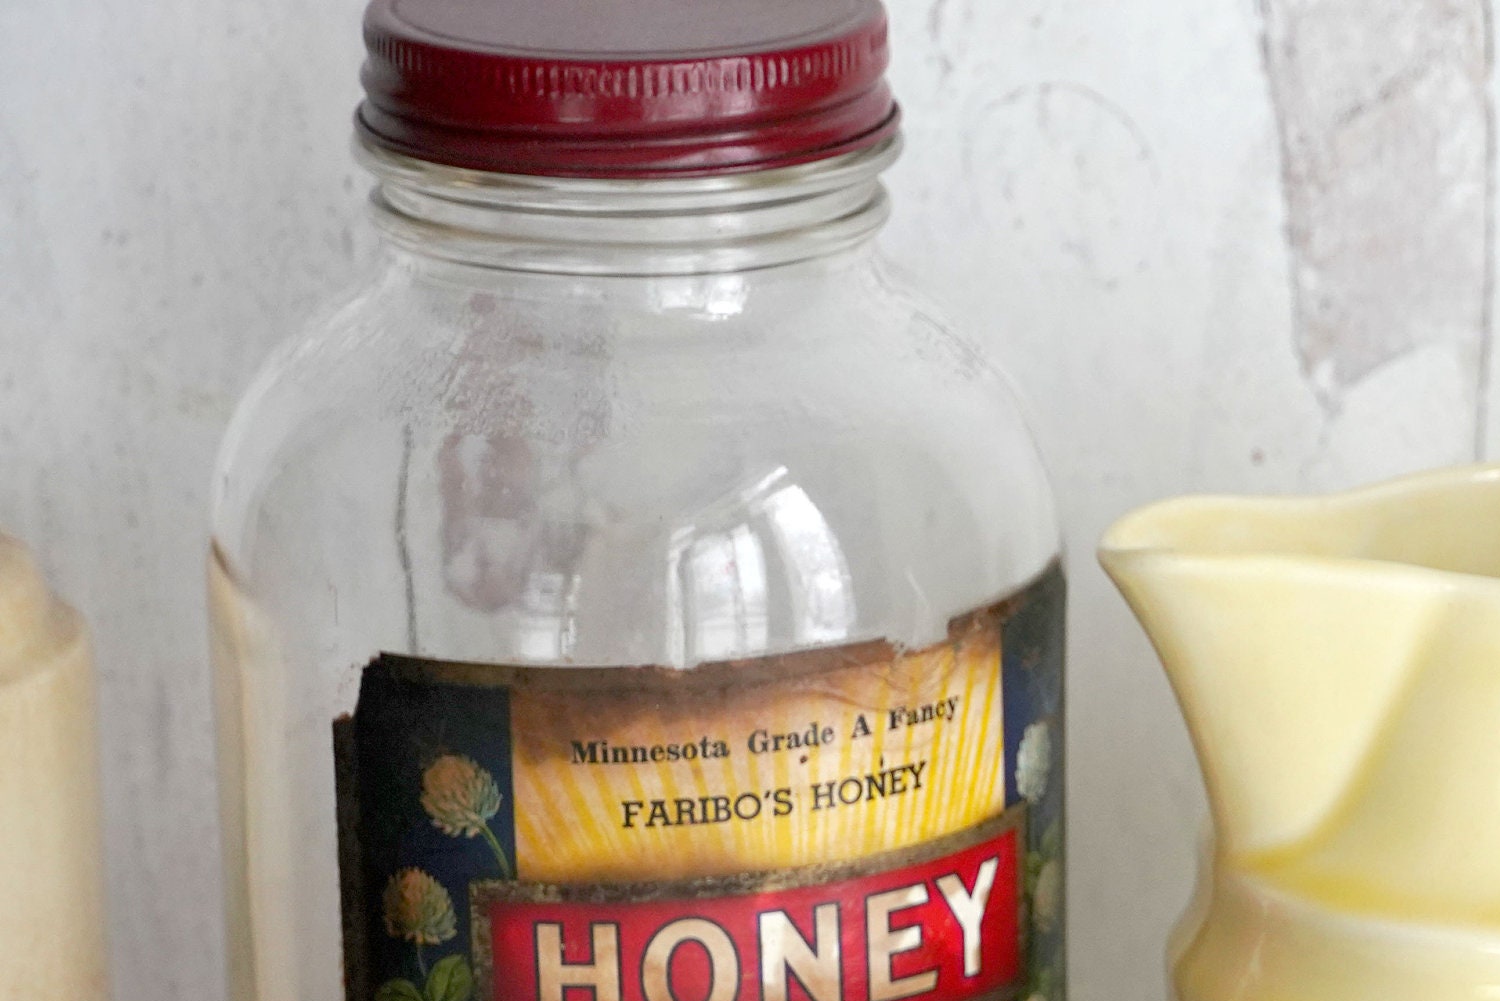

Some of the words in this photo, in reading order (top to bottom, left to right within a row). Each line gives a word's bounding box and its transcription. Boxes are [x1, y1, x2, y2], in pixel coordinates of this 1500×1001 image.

[571, 735, 730, 765] Minnesota
[747, 722, 834, 755] Grade
[851, 713, 871, 739] A
[888, 695, 960, 731] Fancy
[621, 788, 794, 828] FARIBO'S
[810, 761, 926, 811] HONEY
